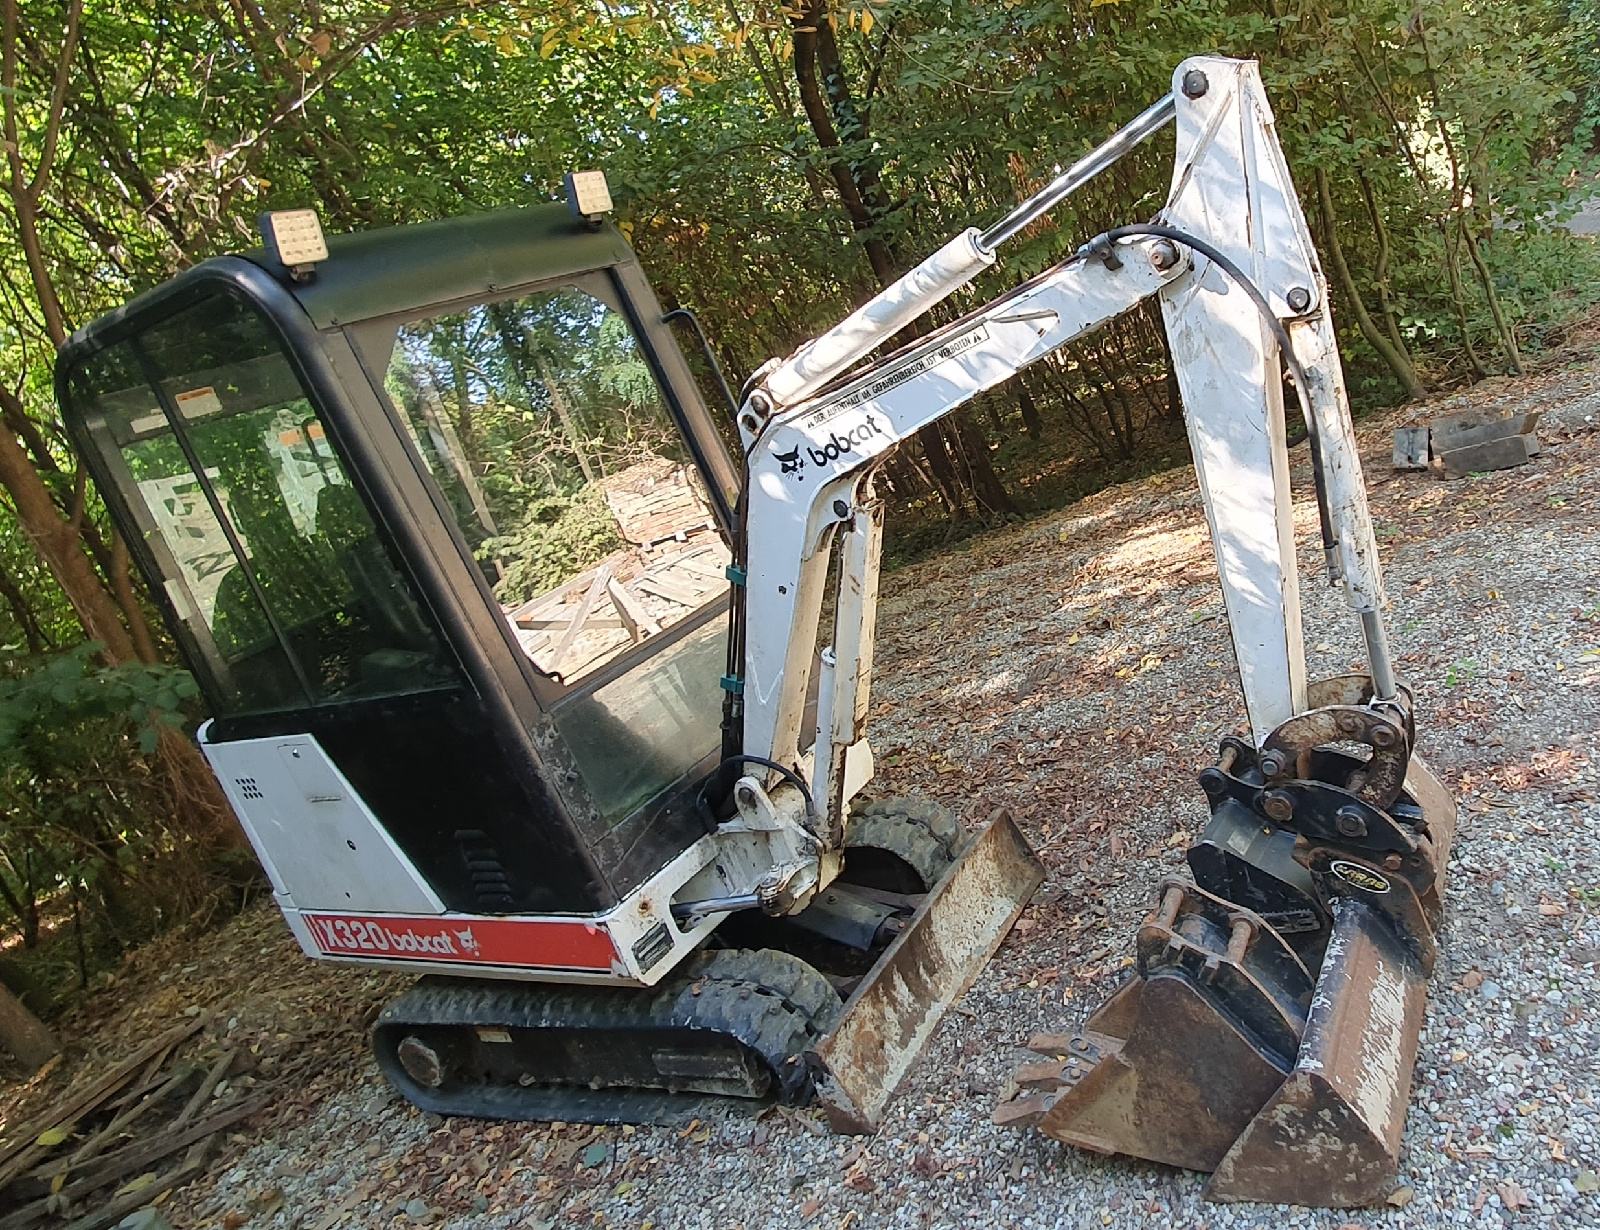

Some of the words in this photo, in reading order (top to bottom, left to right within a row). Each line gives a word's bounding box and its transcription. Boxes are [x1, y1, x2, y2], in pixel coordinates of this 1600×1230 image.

[813, 412, 826, 424] DER
[827, 394, 861, 417] AUFENTHALT
[861, 389, 872, 400] IM
[872, 360, 926, 394] GEFAHRENBEREICH
[926, 354, 937, 366] IST
[937, 336, 971, 359] VERBOTEN
[807, 414, 882, 467] bobcat
[318, 919, 390, 951] X320
[384, 927, 459, 955] bobcat
